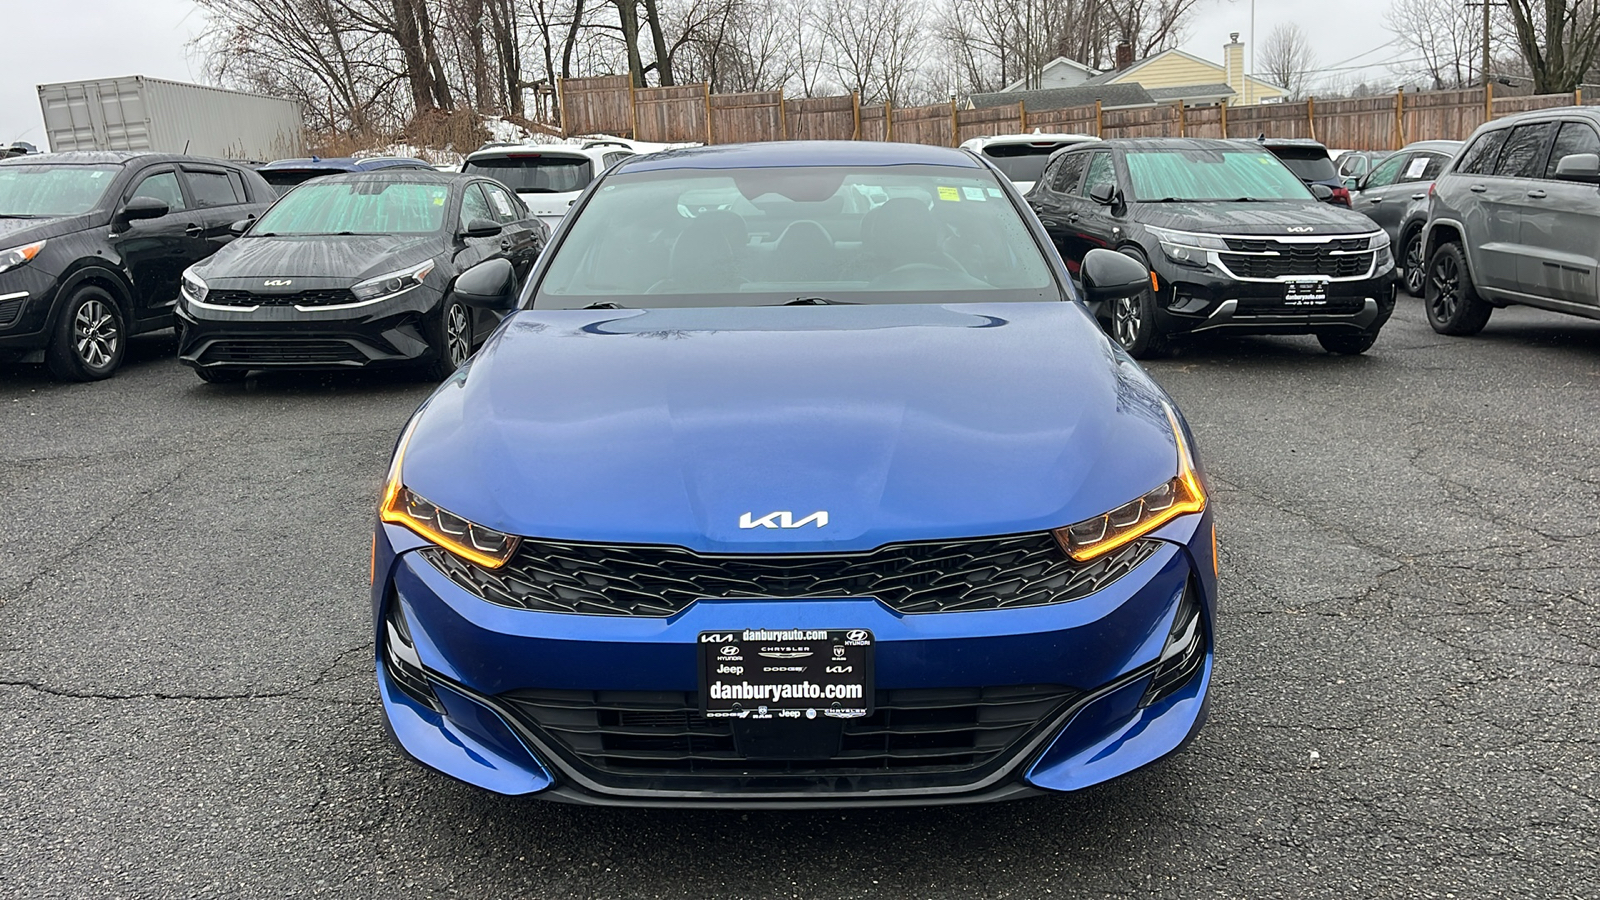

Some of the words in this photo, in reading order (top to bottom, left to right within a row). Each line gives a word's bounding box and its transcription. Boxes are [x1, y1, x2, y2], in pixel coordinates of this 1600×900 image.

[739, 511, 829, 529] KIA
[701, 633, 734, 643] KIA
[743, 629, 828, 642] danburyauto.com
[716, 663, 744, 676] Jeep
[825, 665, 853, 673] KIA
[710, 681, 863, 702] danburyauto.com
[778, 708, 801, 719] Jeep
